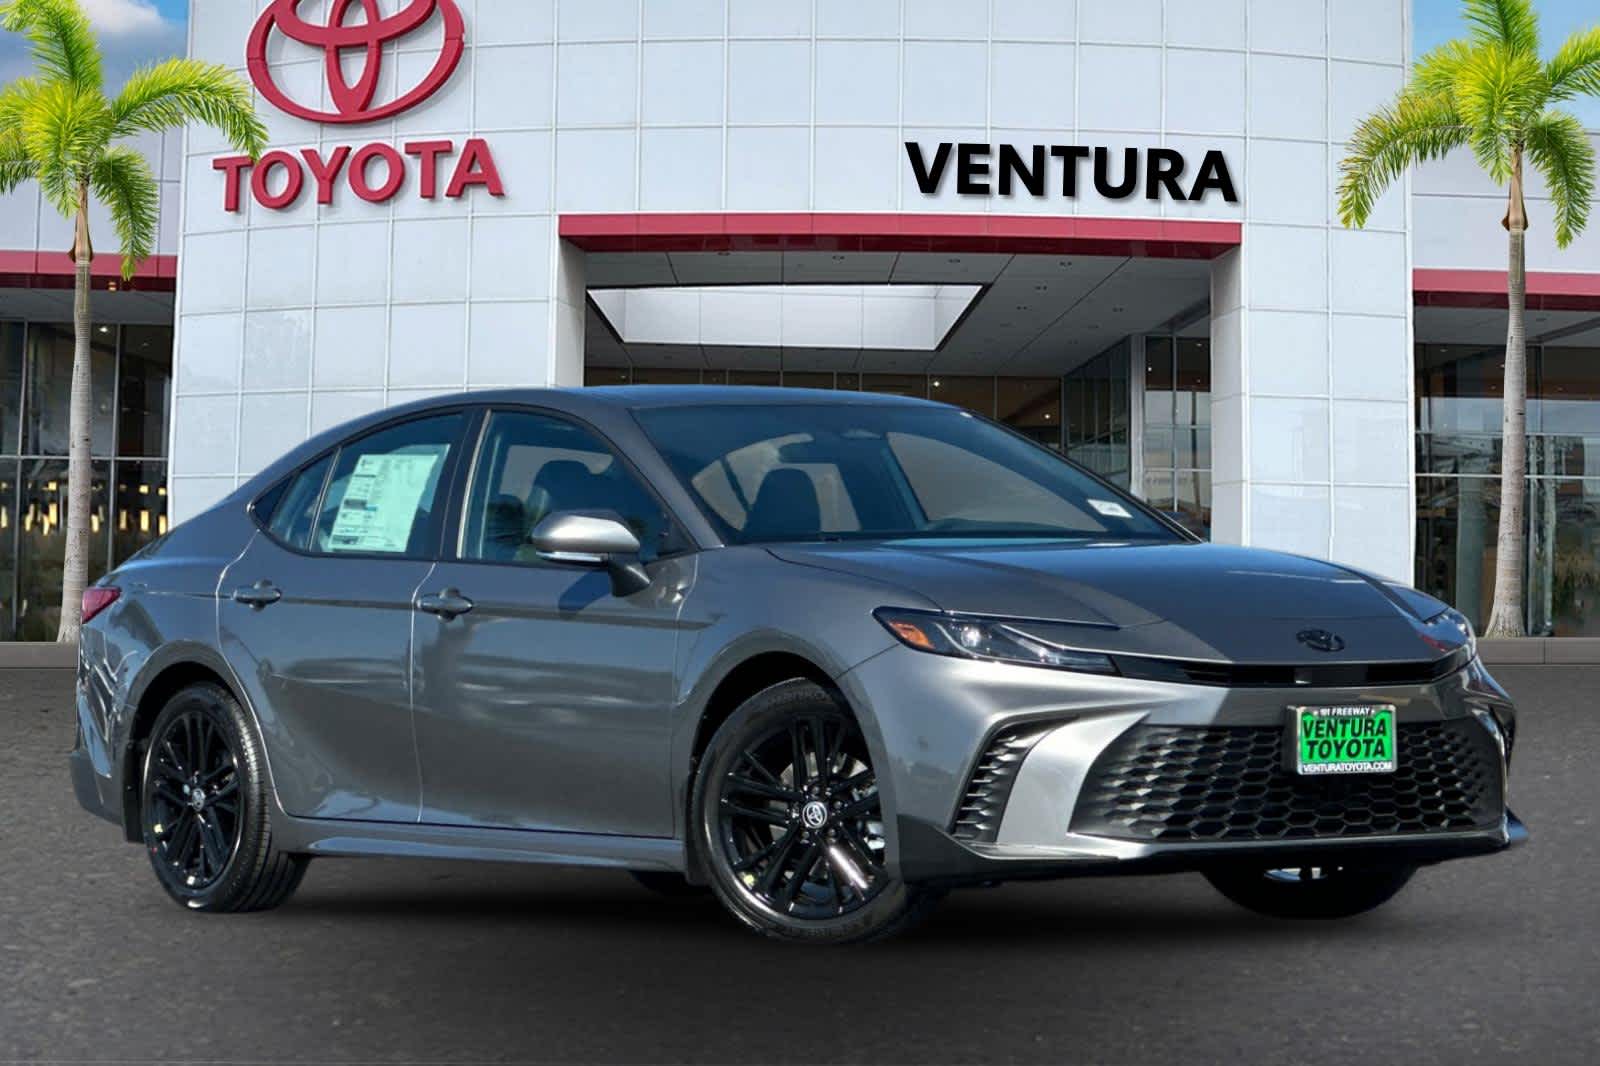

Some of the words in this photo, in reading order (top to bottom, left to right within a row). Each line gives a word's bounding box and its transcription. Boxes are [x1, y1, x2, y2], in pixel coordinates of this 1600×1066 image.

[212, 138, 505, 212] TOYOTA
[904, 142, 1238, 203] VENTURA
[1331, 707, 1370, 716] FREEWAY
[1303, 718, 1387, 738] VENTURA
[1306, 738, 1386, 759] TOYOTA
[1303, 761, 1393, 772] VENTURATOYOTA.COM
